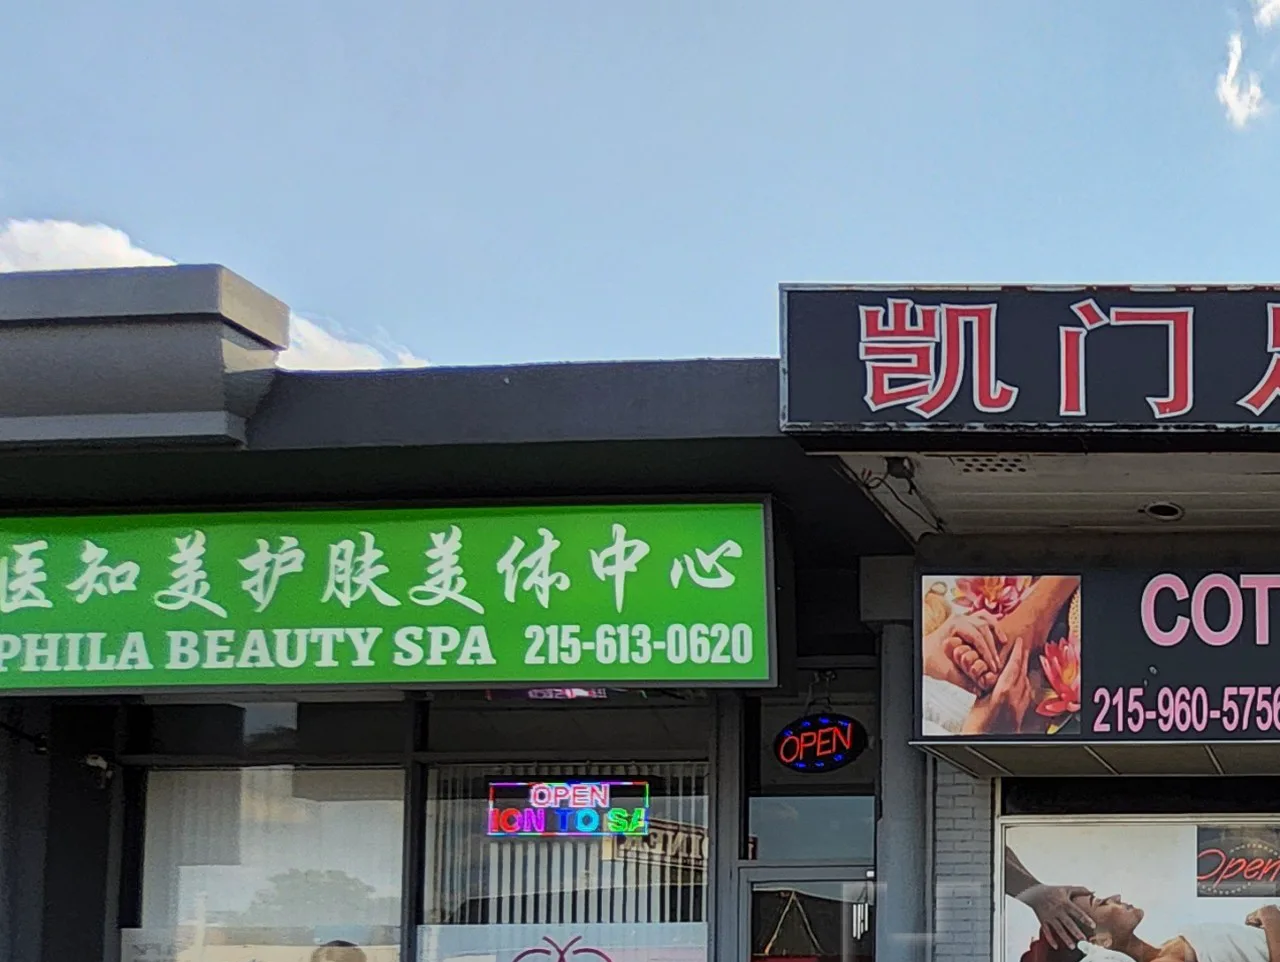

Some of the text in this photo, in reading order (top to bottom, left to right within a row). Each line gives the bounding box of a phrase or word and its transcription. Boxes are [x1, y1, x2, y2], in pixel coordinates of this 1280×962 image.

[0, 623, 753, 672] PHILA BEAUTY SPA 215-613-0620
[780, 723, 852, 763] OPEN
[530, 783, 610, 808] OPEN
[556, 809, 600, 832] TO
